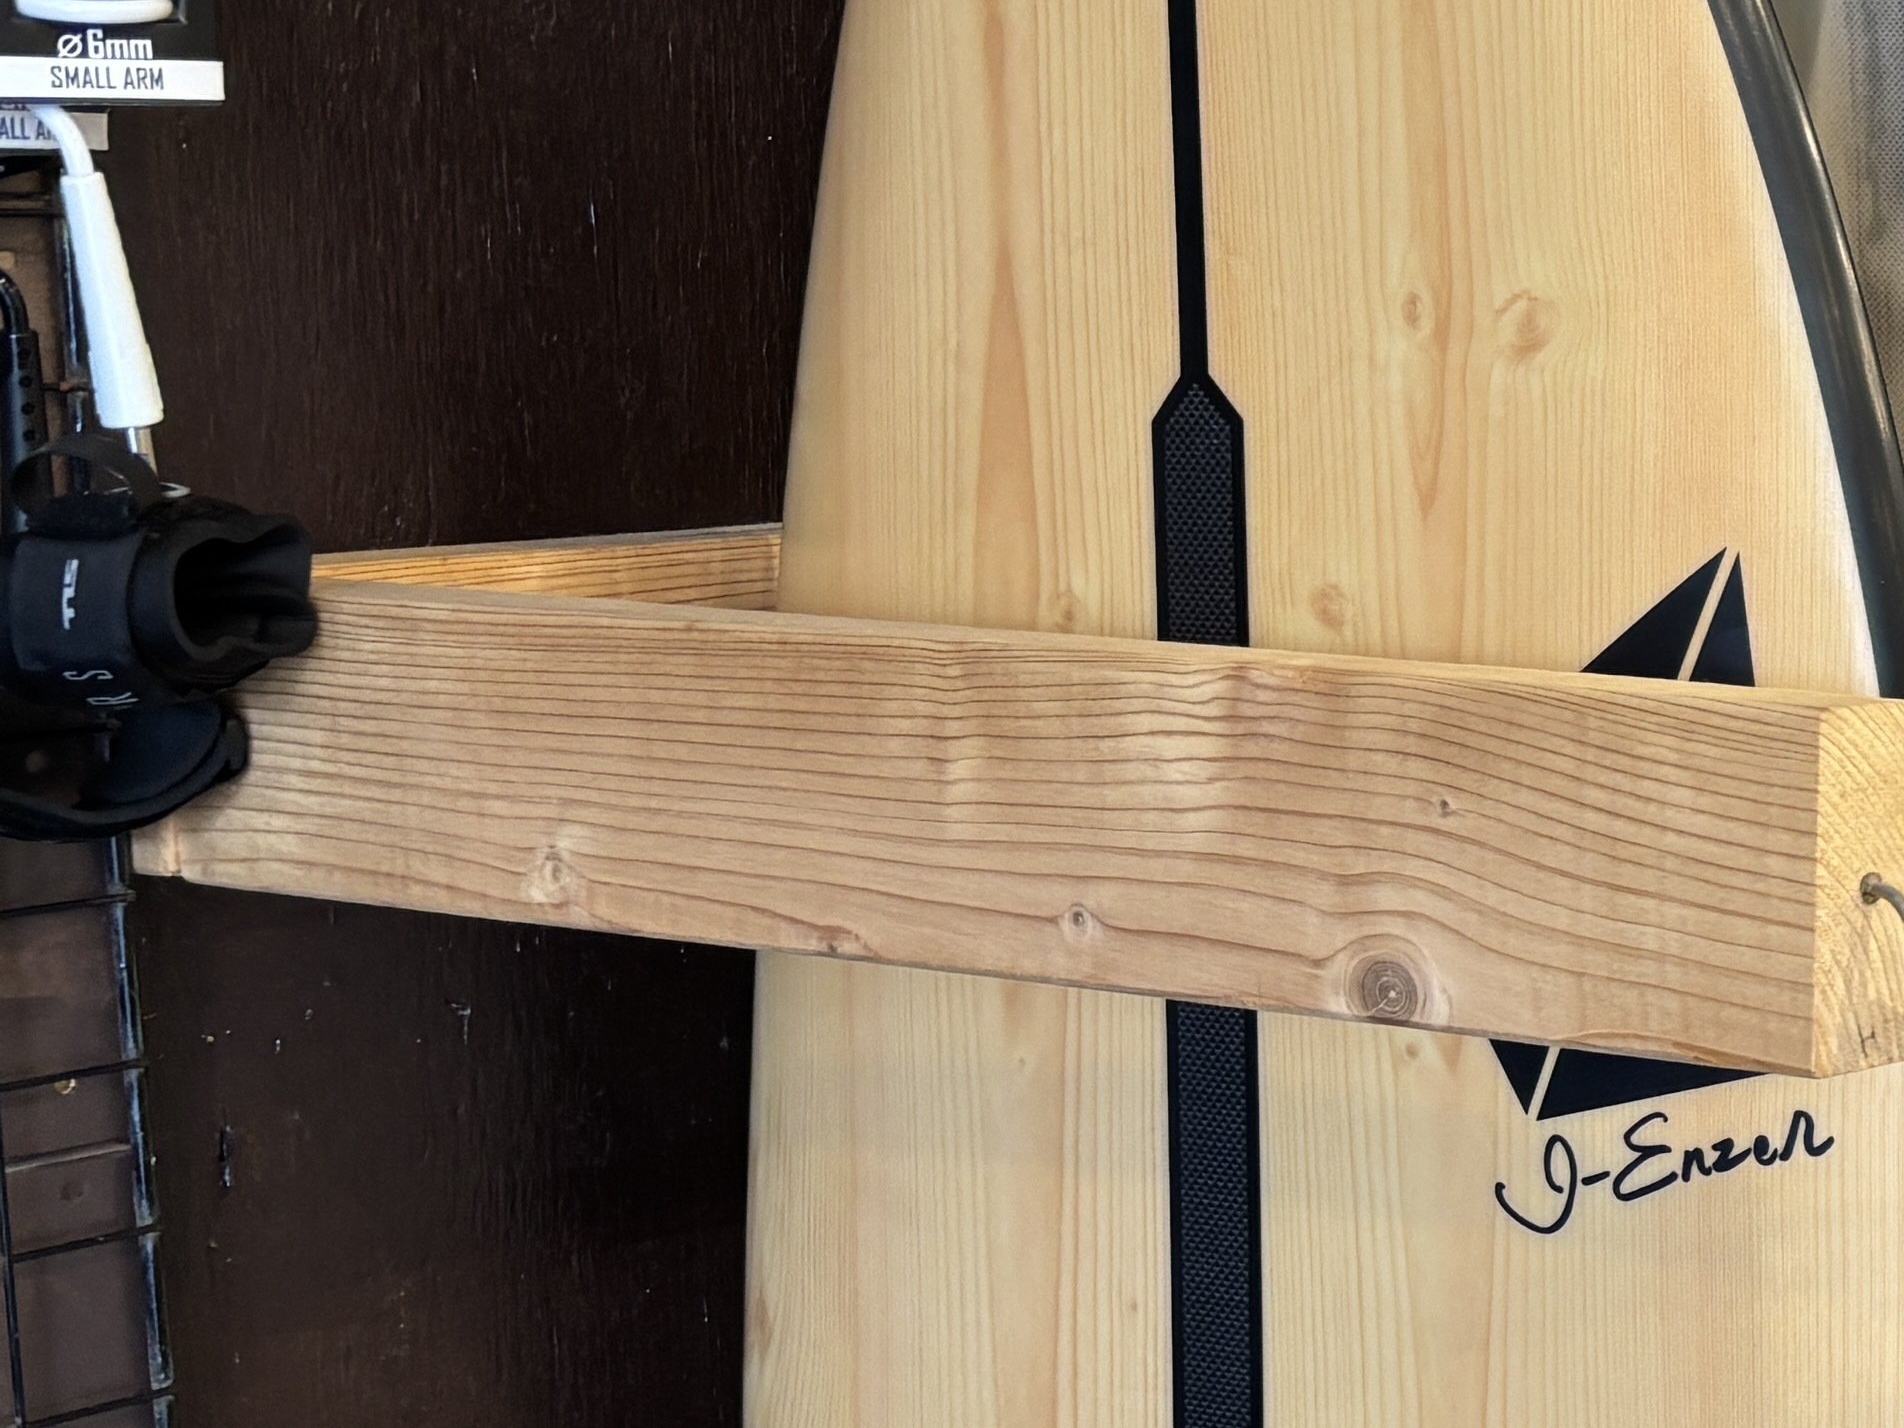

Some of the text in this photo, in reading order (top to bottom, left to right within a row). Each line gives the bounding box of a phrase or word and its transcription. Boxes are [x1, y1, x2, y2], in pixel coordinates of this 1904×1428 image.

[86, 29, 153, 60] 6mm
[51, 66, 164, 90] SMALL ARM
